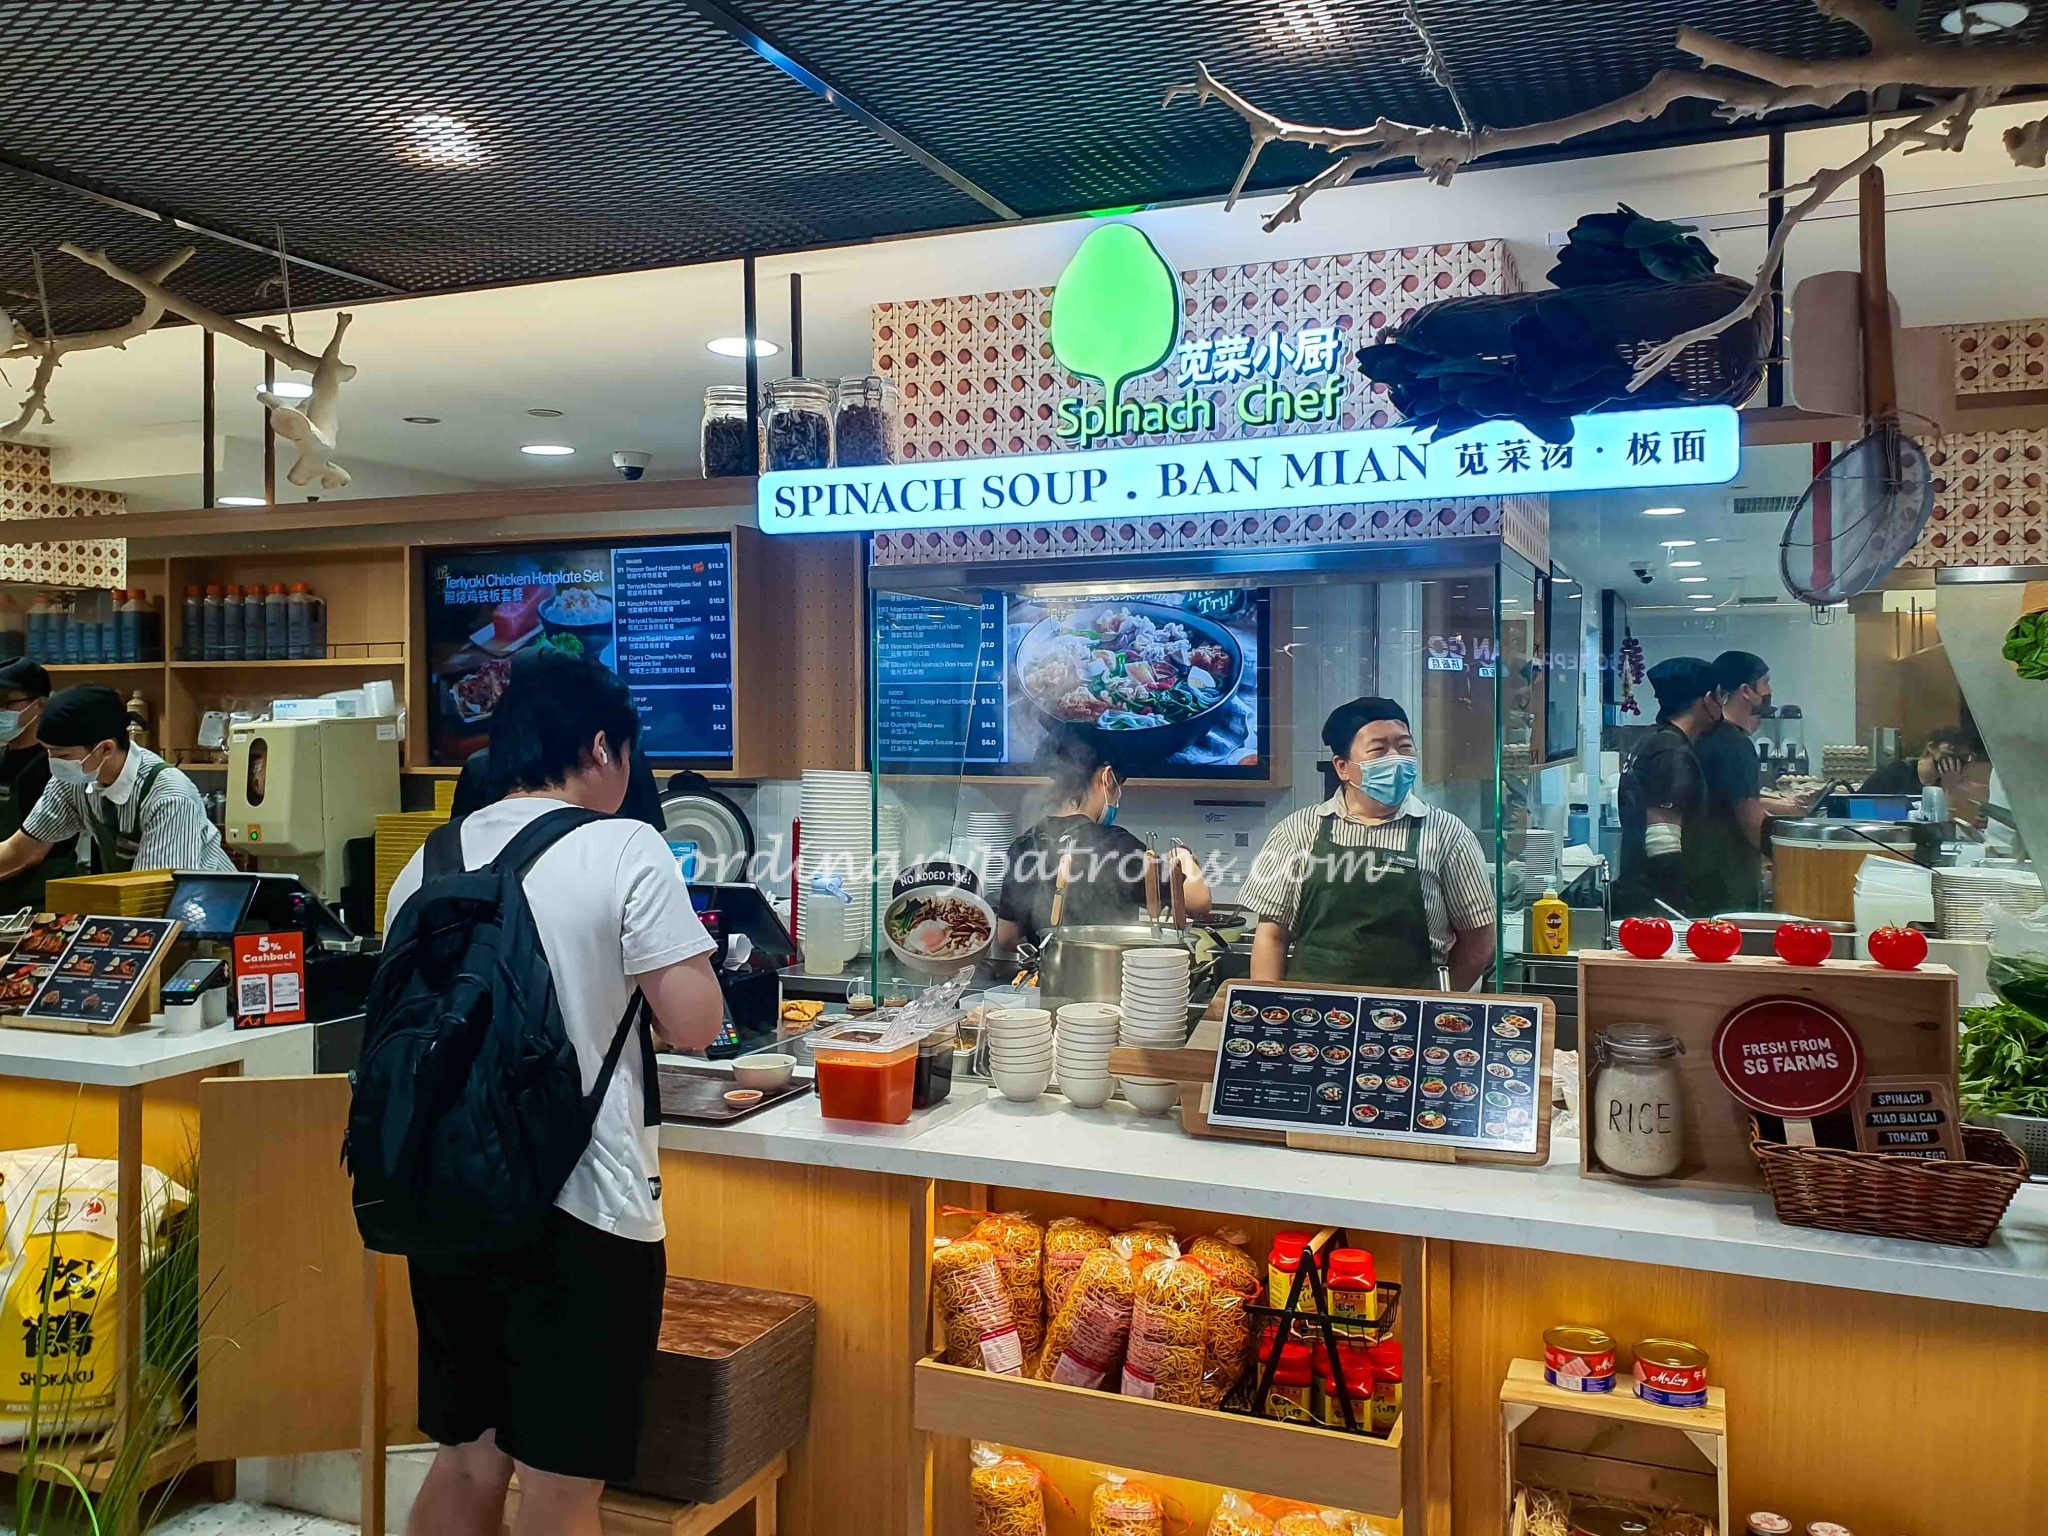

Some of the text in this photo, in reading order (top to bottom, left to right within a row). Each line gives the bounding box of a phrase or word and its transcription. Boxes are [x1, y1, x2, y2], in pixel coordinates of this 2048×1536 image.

[1177, 327, 1341, 384] 苋菜小厨
[1056, 375, 1343, 447] Spinach Chef
[774, 478, 966, 519] SPINACH
[982, 468, 1107, 511] SOUP
[1157, 456, 1260, 499] BAN
[1281, 443, 1429, 489] MIAN
[1455, 439, 1575, 477] 苋菜汤
[1626, 429, 1708, 467] 板面
[444, 569, 605, 592] Teriyaki Chicken Hotplate Set
[1198, 590, 1234, 614] Try!
[900, 870, 972, 887] NO ADDED MSG!
[257, 936, 282, 952] 5%
[242, 951, 297, 963] Cashback
[1742, 1037, 1832, 1056] FRESH FROM
[1743, 1052, 1839, 1075] SG FARMS
[1878, 1093, 1925, 1105] SPINACH
[1609, 1099, 1672, 1134] RICE
[1872, 1111, 1937, 1124] XIAO BAI CAI
[1886, 1131, 1929, 1143] TOMATO
[19, 1369, 94, 1388] SHOKAKU
